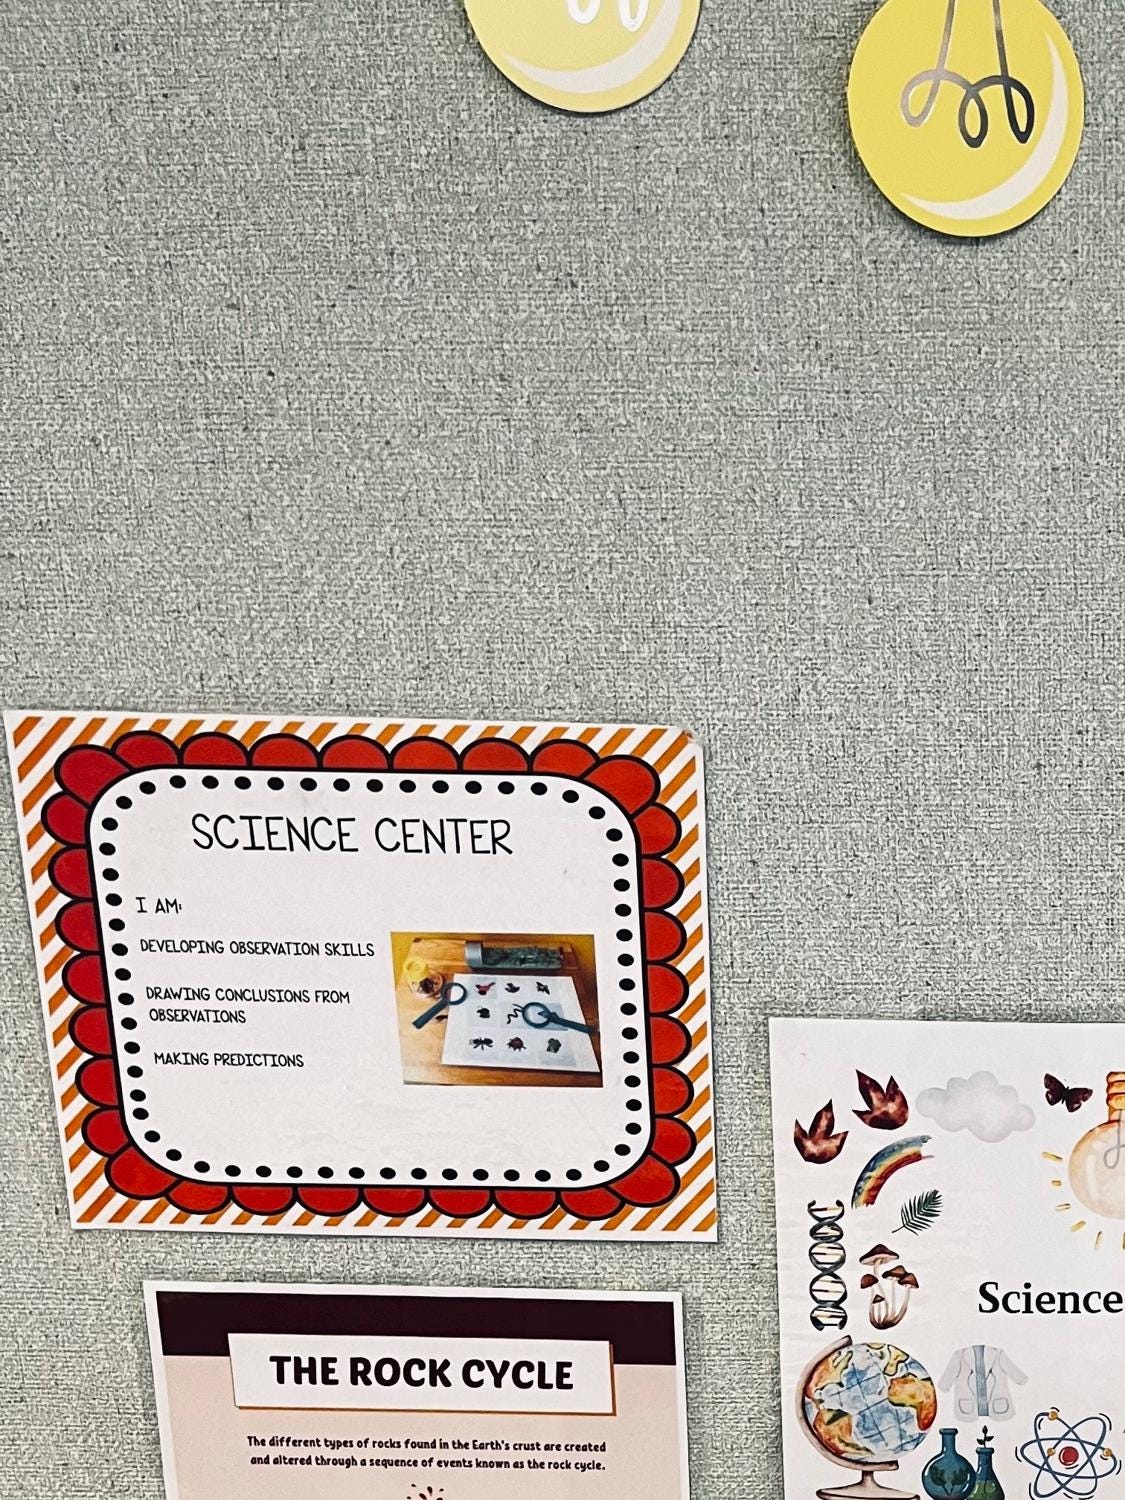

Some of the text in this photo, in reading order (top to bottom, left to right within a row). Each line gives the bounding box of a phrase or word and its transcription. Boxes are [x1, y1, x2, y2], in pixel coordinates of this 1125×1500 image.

[191, 813, 513, 855] SCIENCE CENTER
[135, 896, 148, 914] I
[140, 938, 375, 957] DEVELOPING OBSERVATION SKILLS
[145, 986, 351, 1004] DRAWING CONCLUSIONS FROM
[149, 1008, 247, 1024] OBSERVATIONS
[153, 1051, 305, 1068] MAKING PREDICTIONS
[978, 1281, 1124, 1314] Science
[269, 1355, 574, 1390] THE ROCK CYCLE
[246, 1435, 607, 1453] The different types of rocks found in the Earth's crust are created
[250, 1454, 606, 1473] and altered through a sequence of events known as the rock cycle.
